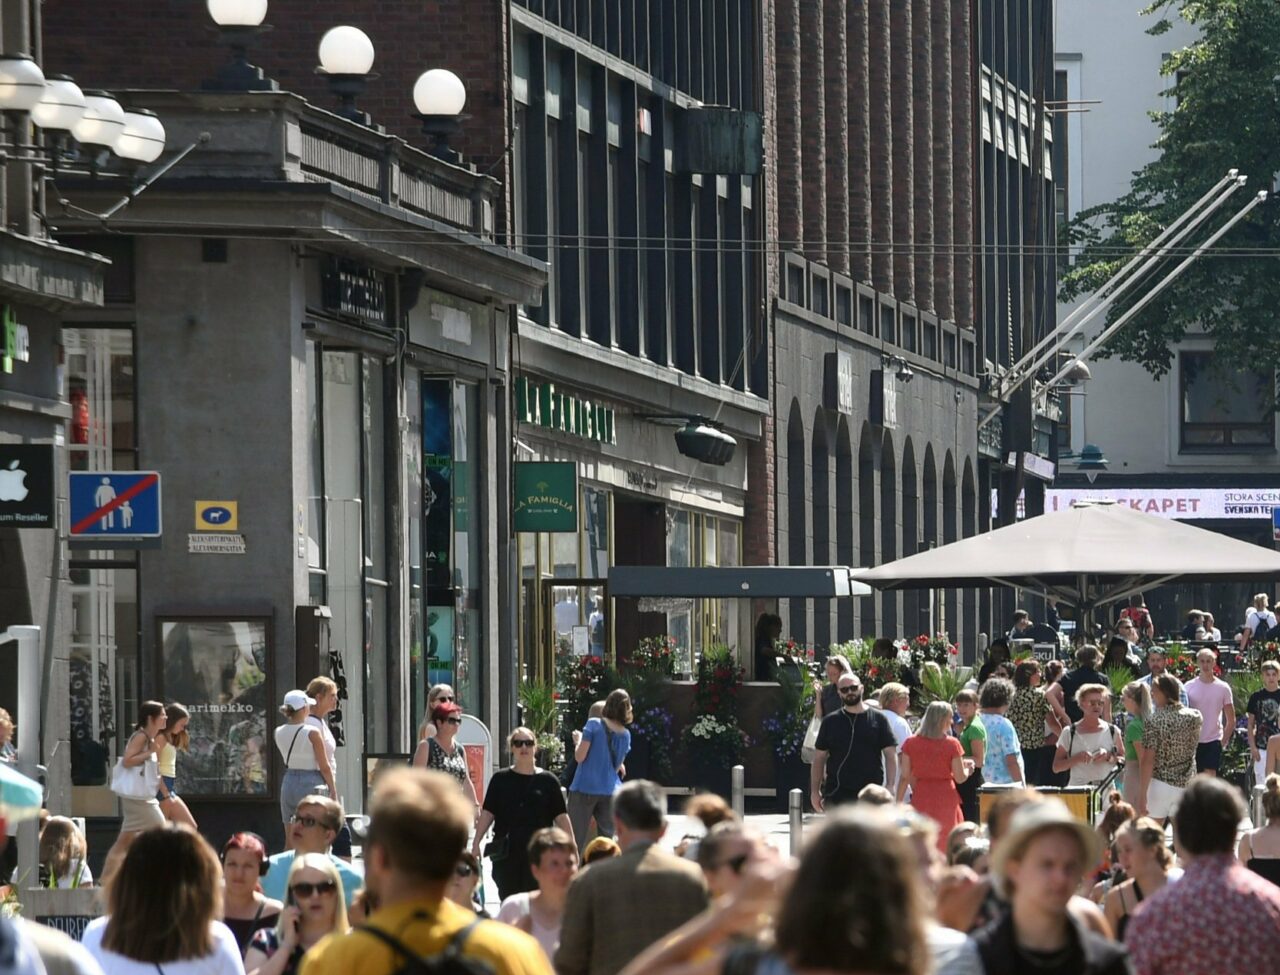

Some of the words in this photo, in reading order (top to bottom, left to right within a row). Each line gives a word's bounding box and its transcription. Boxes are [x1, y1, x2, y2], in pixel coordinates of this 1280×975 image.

[547, 383, 617, 446] FAMIGLIA
[1224, 493, 1253, 501] STORA
[527, 495, 574, 513] FAMIGLIA
[15, 513, 49, 522] Reseller
[186, 703, 254, 714] arimekko
